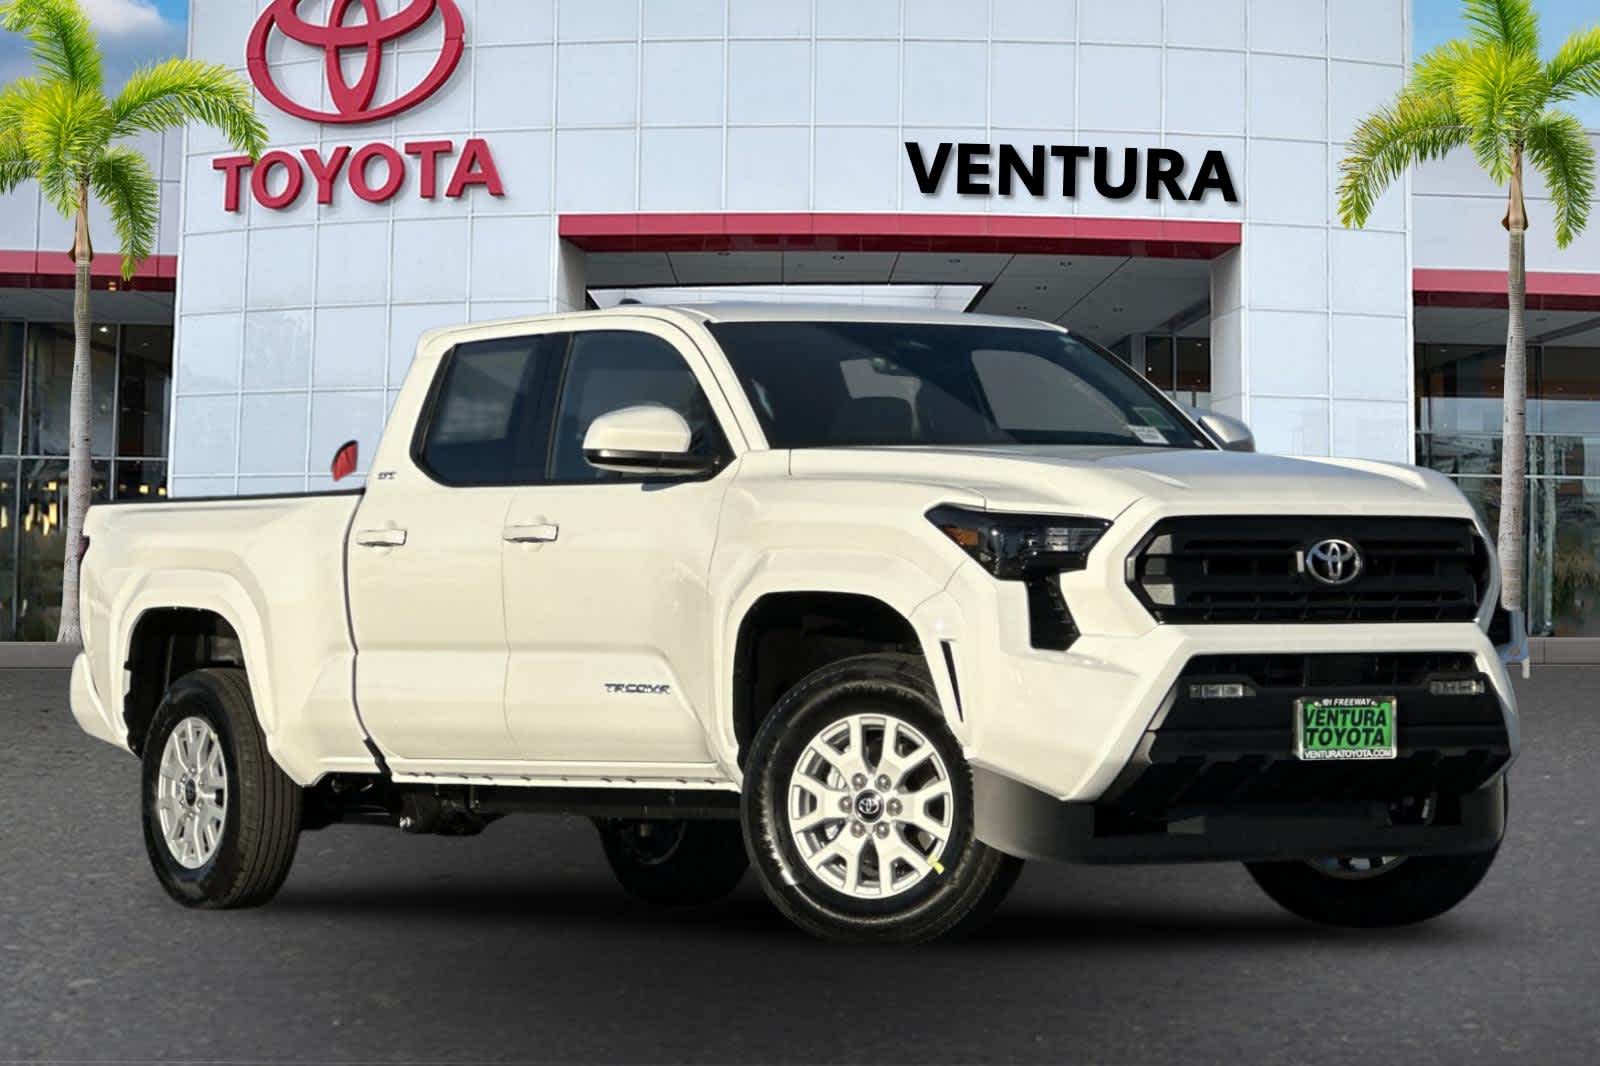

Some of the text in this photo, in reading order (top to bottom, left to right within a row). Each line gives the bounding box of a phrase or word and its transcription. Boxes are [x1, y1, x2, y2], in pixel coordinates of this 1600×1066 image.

[212, 138, 505, 213] TOYOTA
[904, 141, 1239, 203] VENTURA
[1333, 698, 1372, 706] FREEWAY
[1303, 708, 1387, 726] VENTURA
[1305, 727, 1385, 746] TOYOTA
[1304, 749, 1392, 758] VENTURATOYOTA.COM
